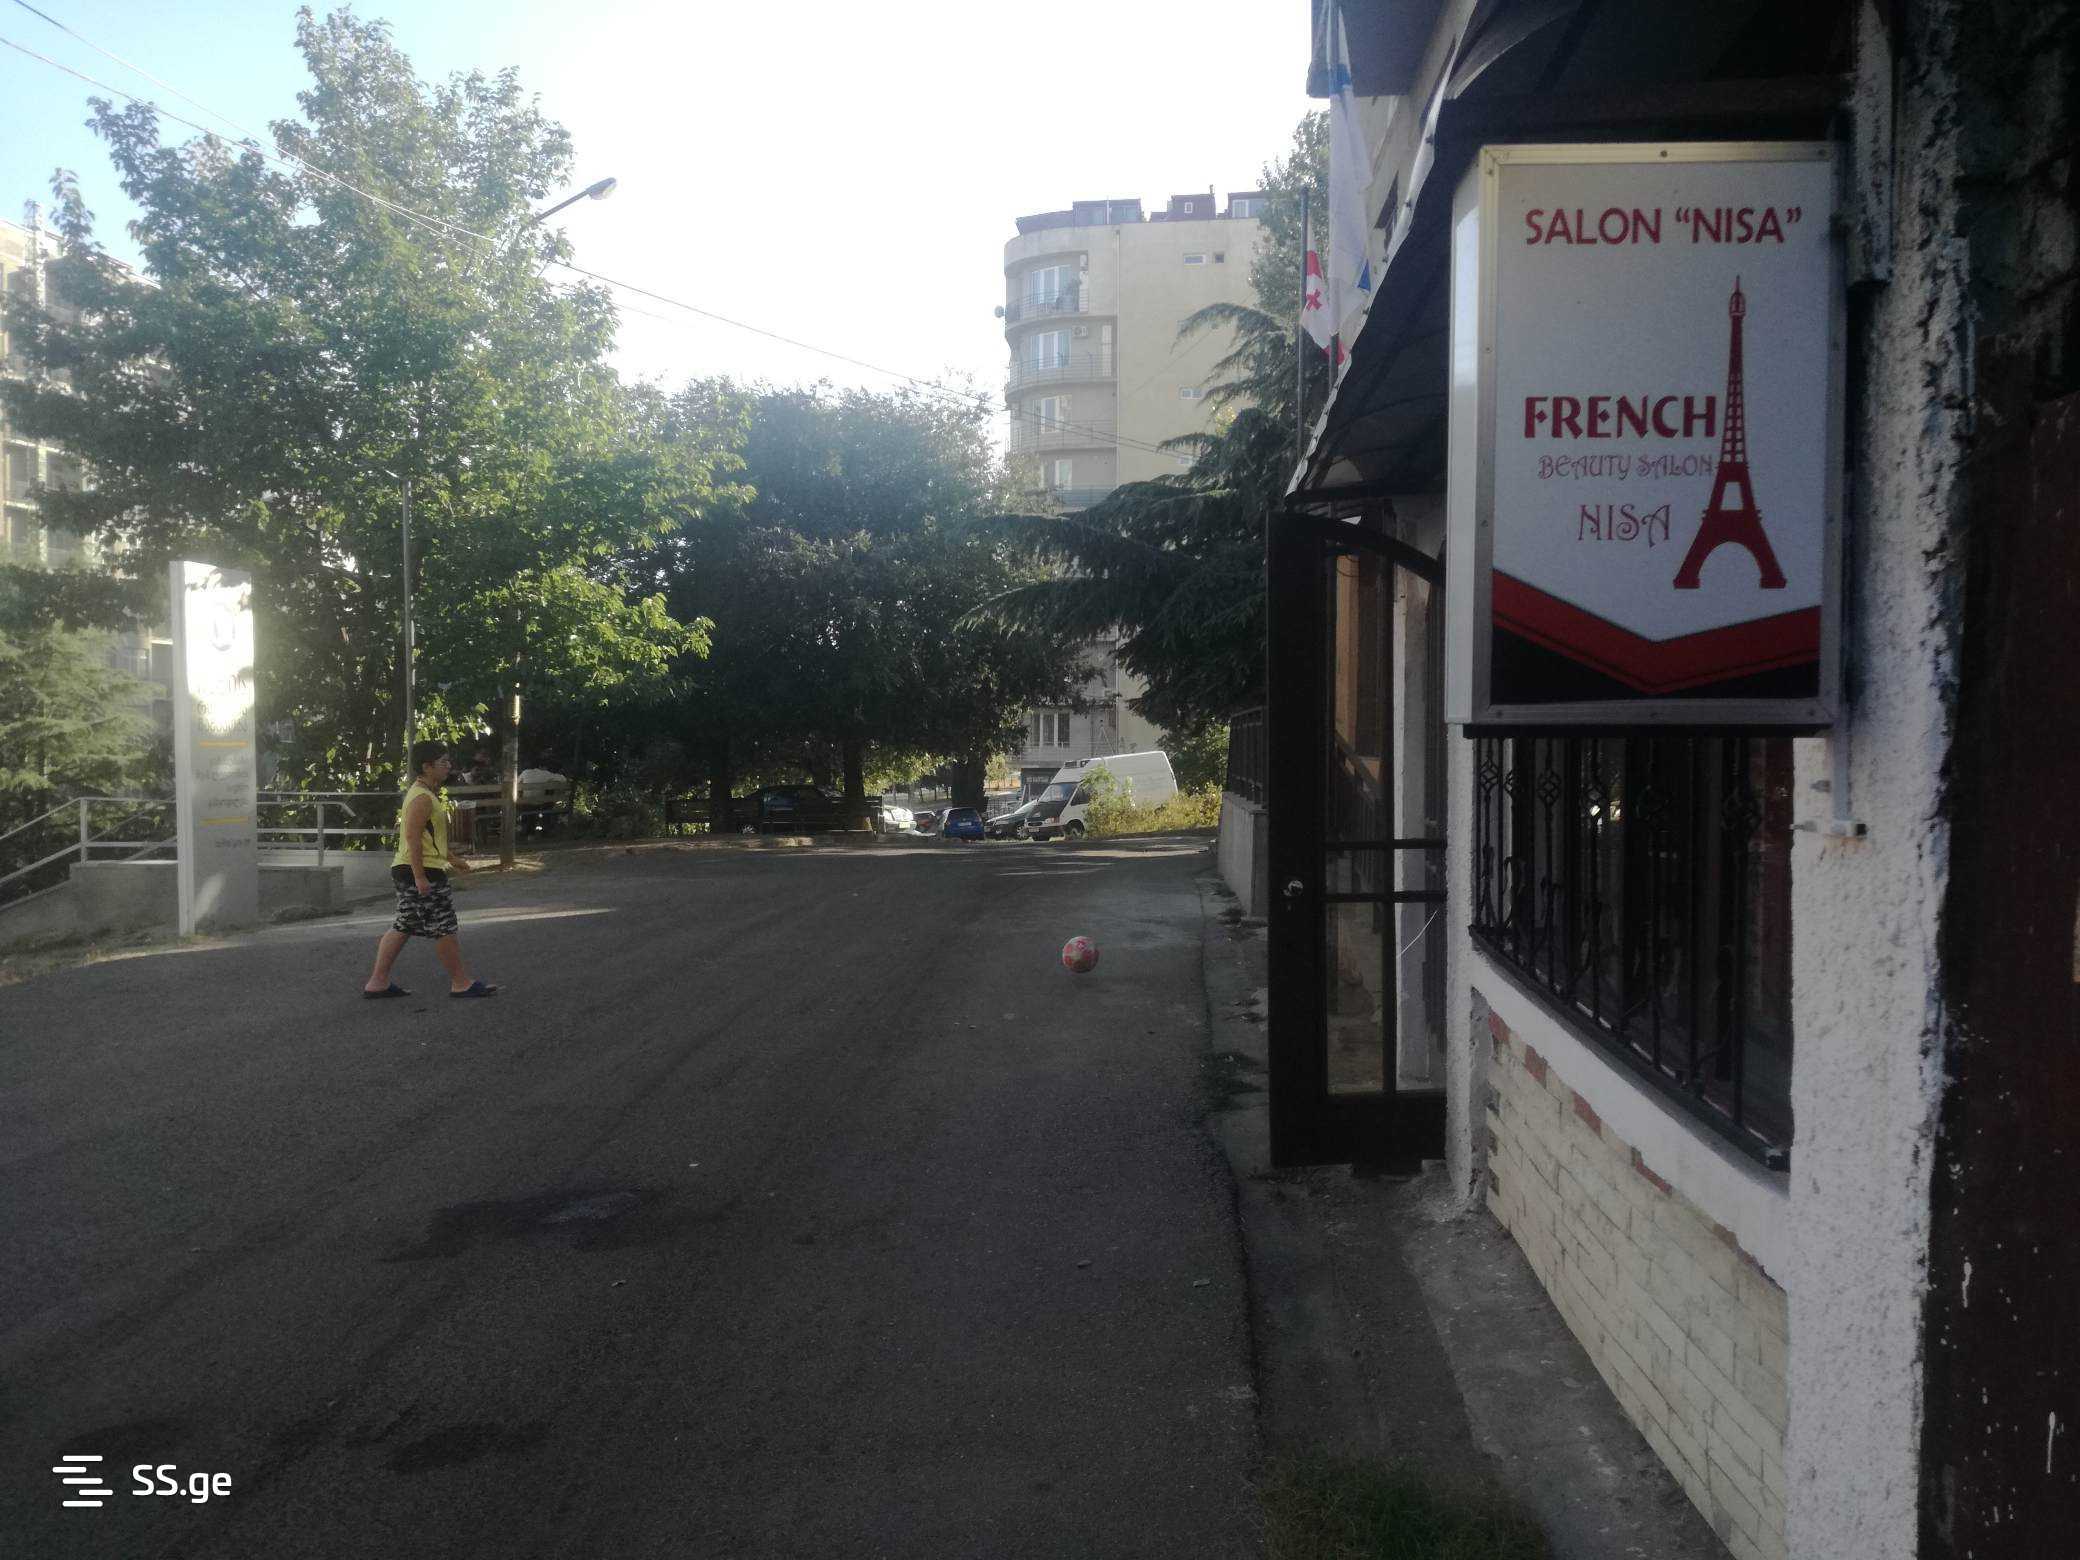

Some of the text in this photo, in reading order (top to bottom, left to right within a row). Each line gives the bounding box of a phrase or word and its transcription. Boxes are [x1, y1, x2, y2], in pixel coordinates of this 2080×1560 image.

[1525, 206, 1661, 245] SALON
[1523, 396, 1717, 439] FRENCH
[1538, 454, 1713, 480] BEAUTY SALON
[1577, 503, 1672, 547] NISA
